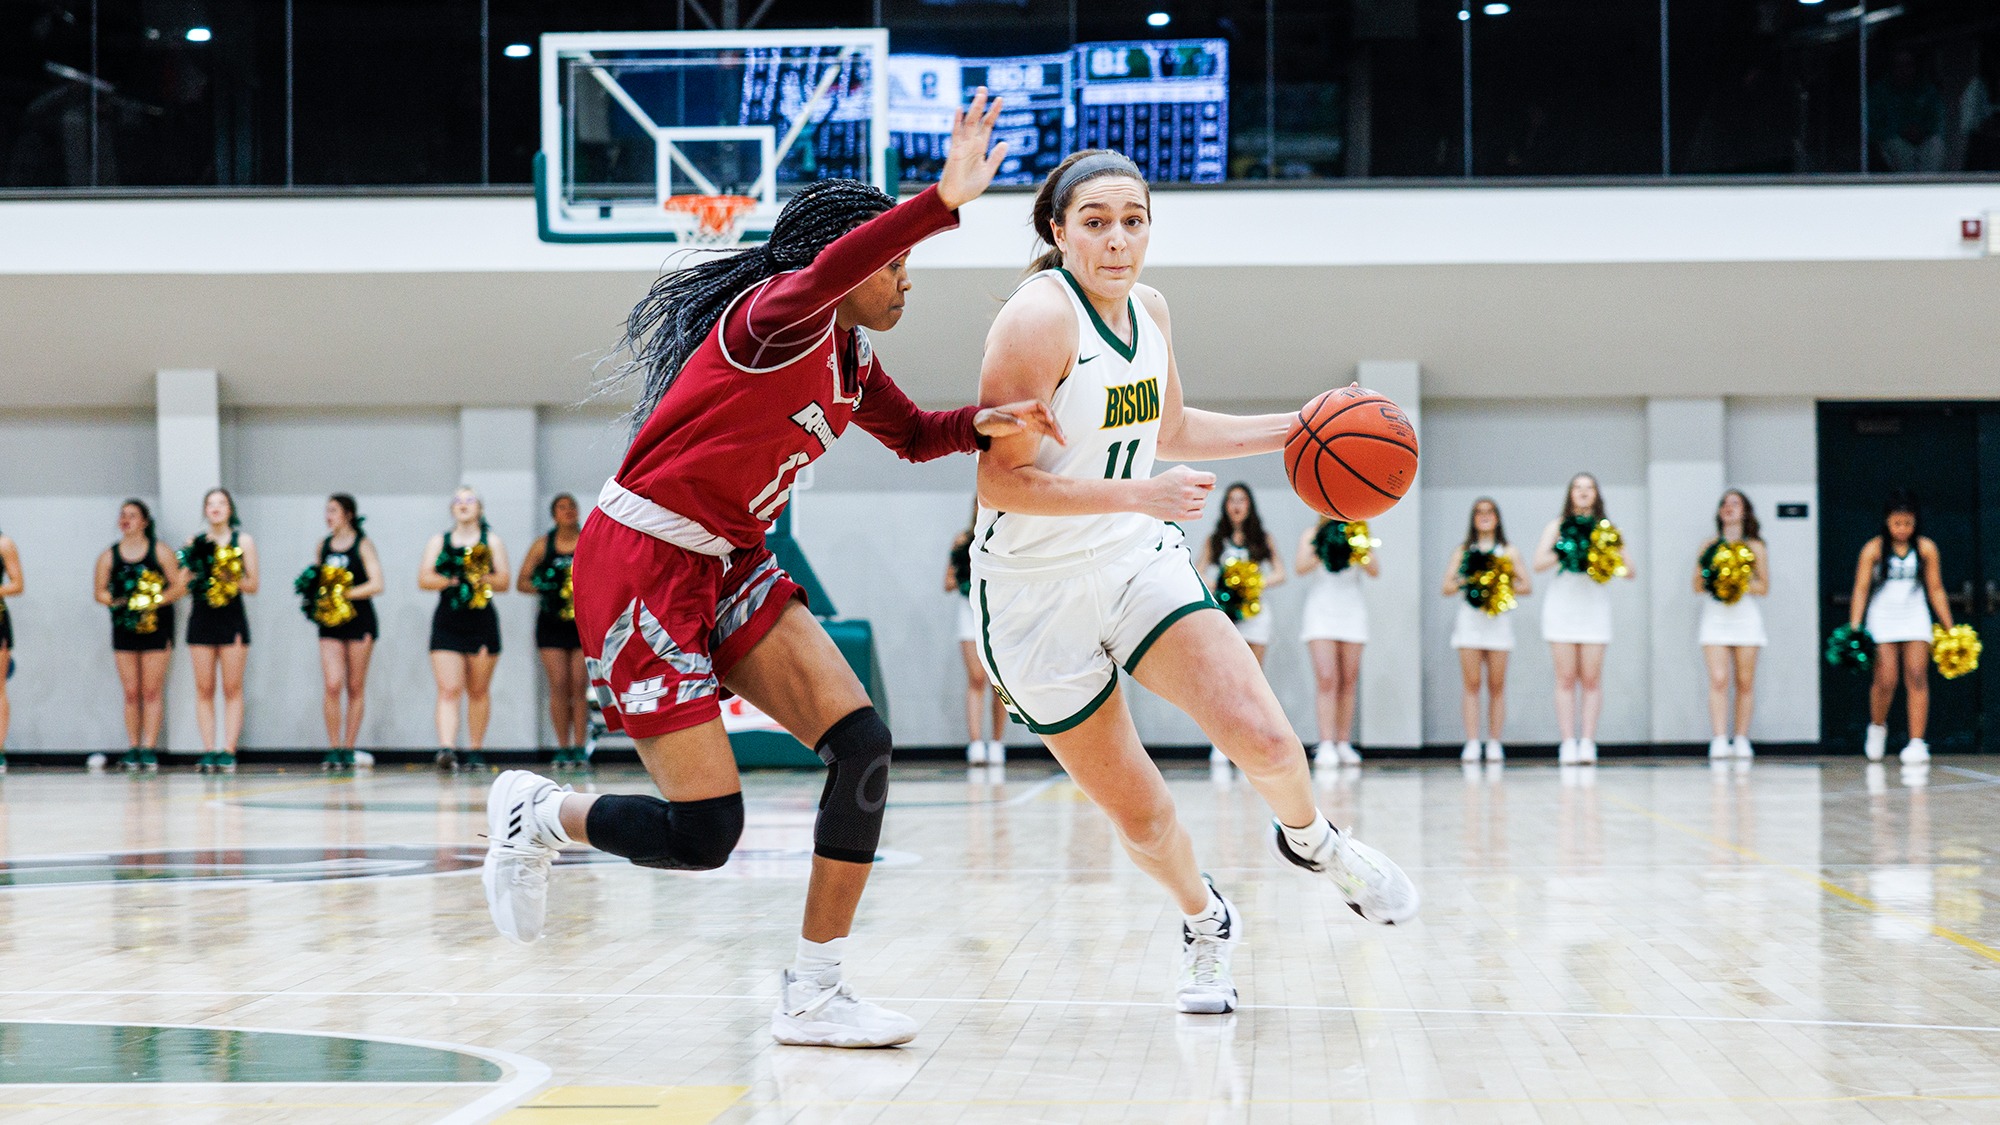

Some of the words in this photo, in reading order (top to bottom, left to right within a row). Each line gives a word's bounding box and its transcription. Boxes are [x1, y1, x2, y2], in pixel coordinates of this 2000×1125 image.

[788, 400, 839, 452] REDDI
[1099, 377, 1160, 430] BISON
[1104, 439, 1141, 479] 11
